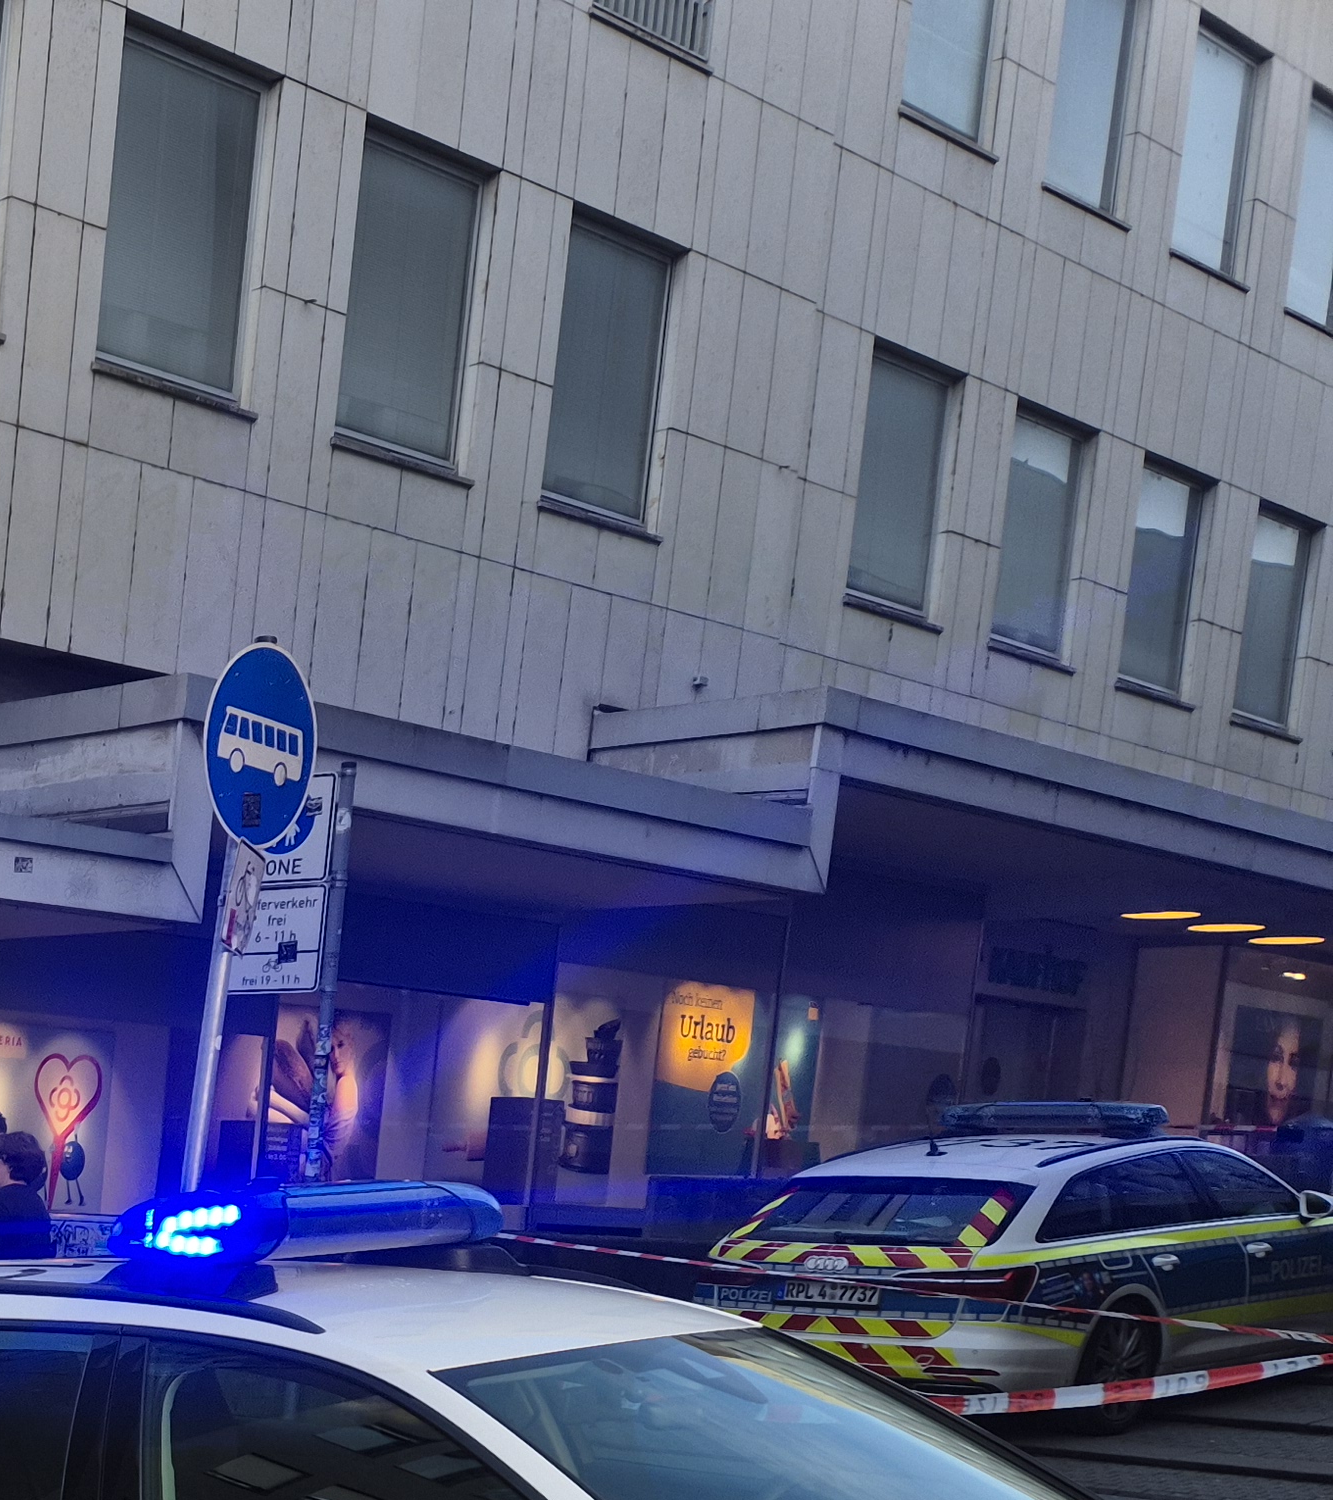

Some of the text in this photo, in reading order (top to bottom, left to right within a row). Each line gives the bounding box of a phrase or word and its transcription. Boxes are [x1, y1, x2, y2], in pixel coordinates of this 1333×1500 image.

[265, 858, 303, 876] ONE
[257, 896, 318, 911] ferverkehr
[267, 914, 287, 926] frei
[255, 932, 261, 943] 6
[274, 931, 284, 942] 11
[290, 930, 296, 940] h
[242, 976, 258, 986] frei
[260, 976, 271, 985] 19
[281, 975, 291, 984] 11
[294, 975, 300, 984] h
[671, 990, 723, 1010] Noch keinen
[680, 1015, 736, 1044] Urlaub
[687, 1046, 727, 1062] gebucht?
[721, 1287, 772, 1303] POLIZEI
[786, 1282, 878, 1303] RPL 4 7737
